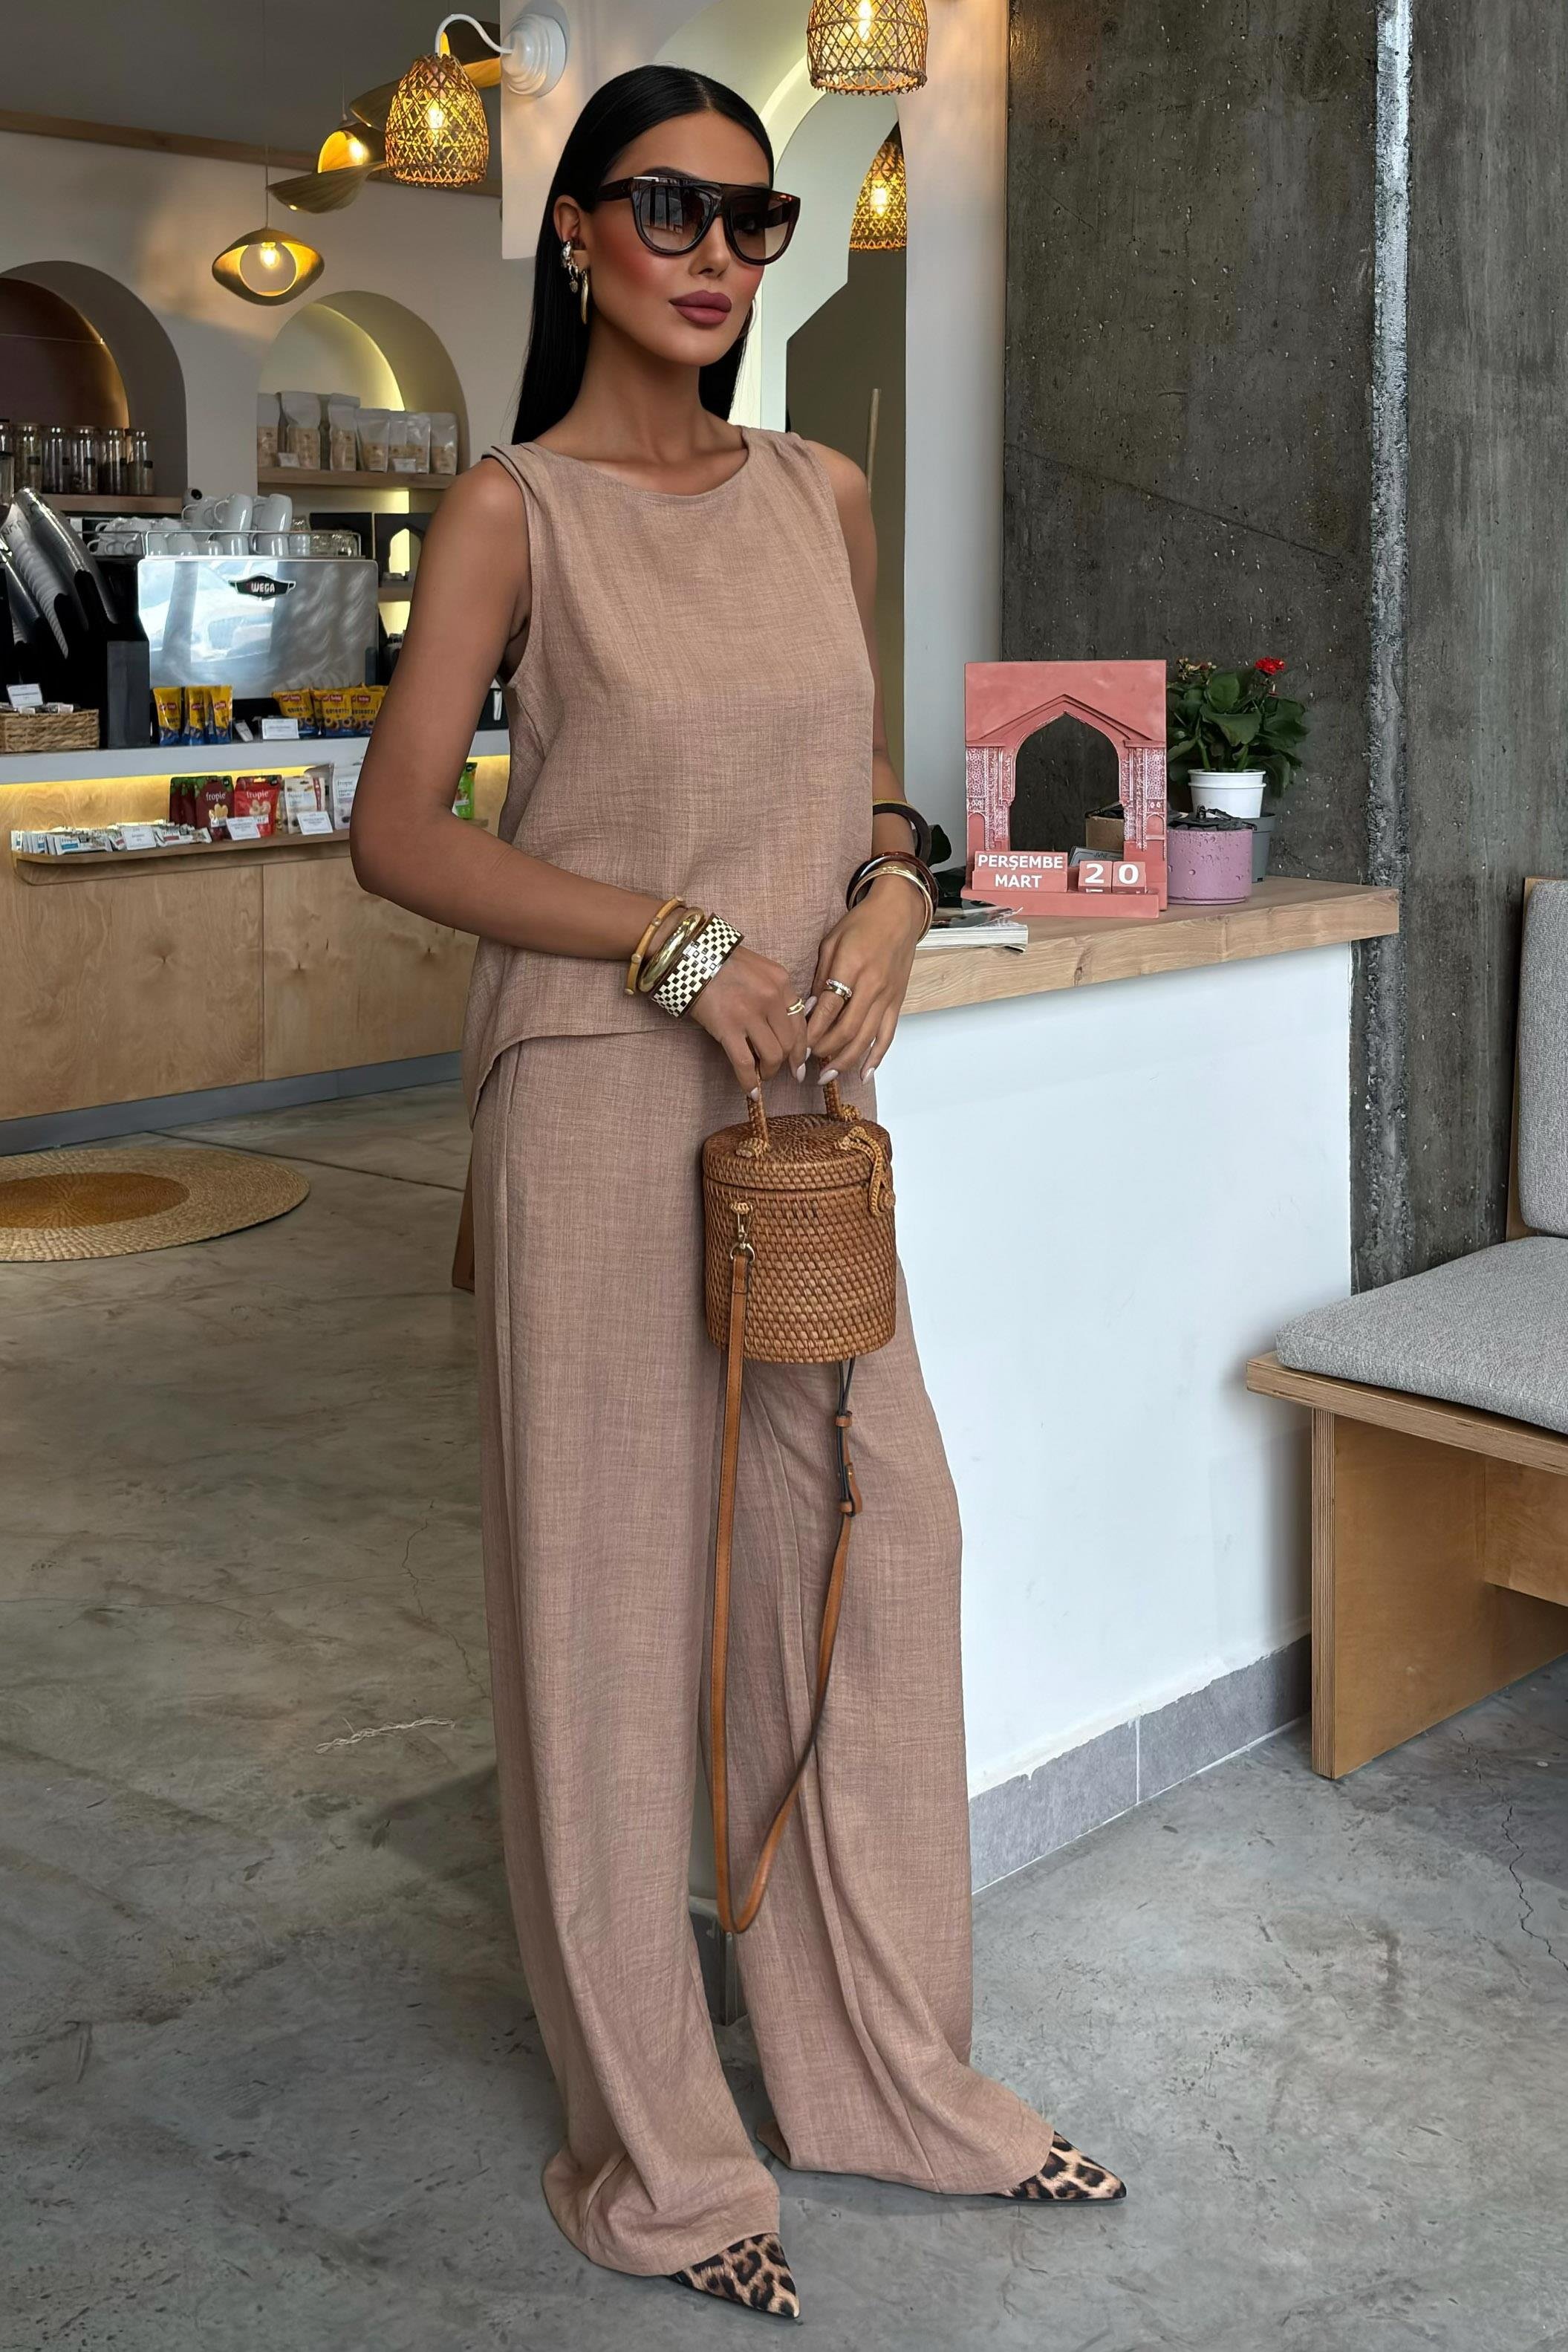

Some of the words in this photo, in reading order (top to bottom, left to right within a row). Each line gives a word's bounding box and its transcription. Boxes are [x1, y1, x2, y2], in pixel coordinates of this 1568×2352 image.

[251, 582, 275, 592] WEGA
[206, 791, 226, 802] fropie
[978, 855, 1063, 870] PERŞEMBE
[995, 874, 1042, 888] MART
